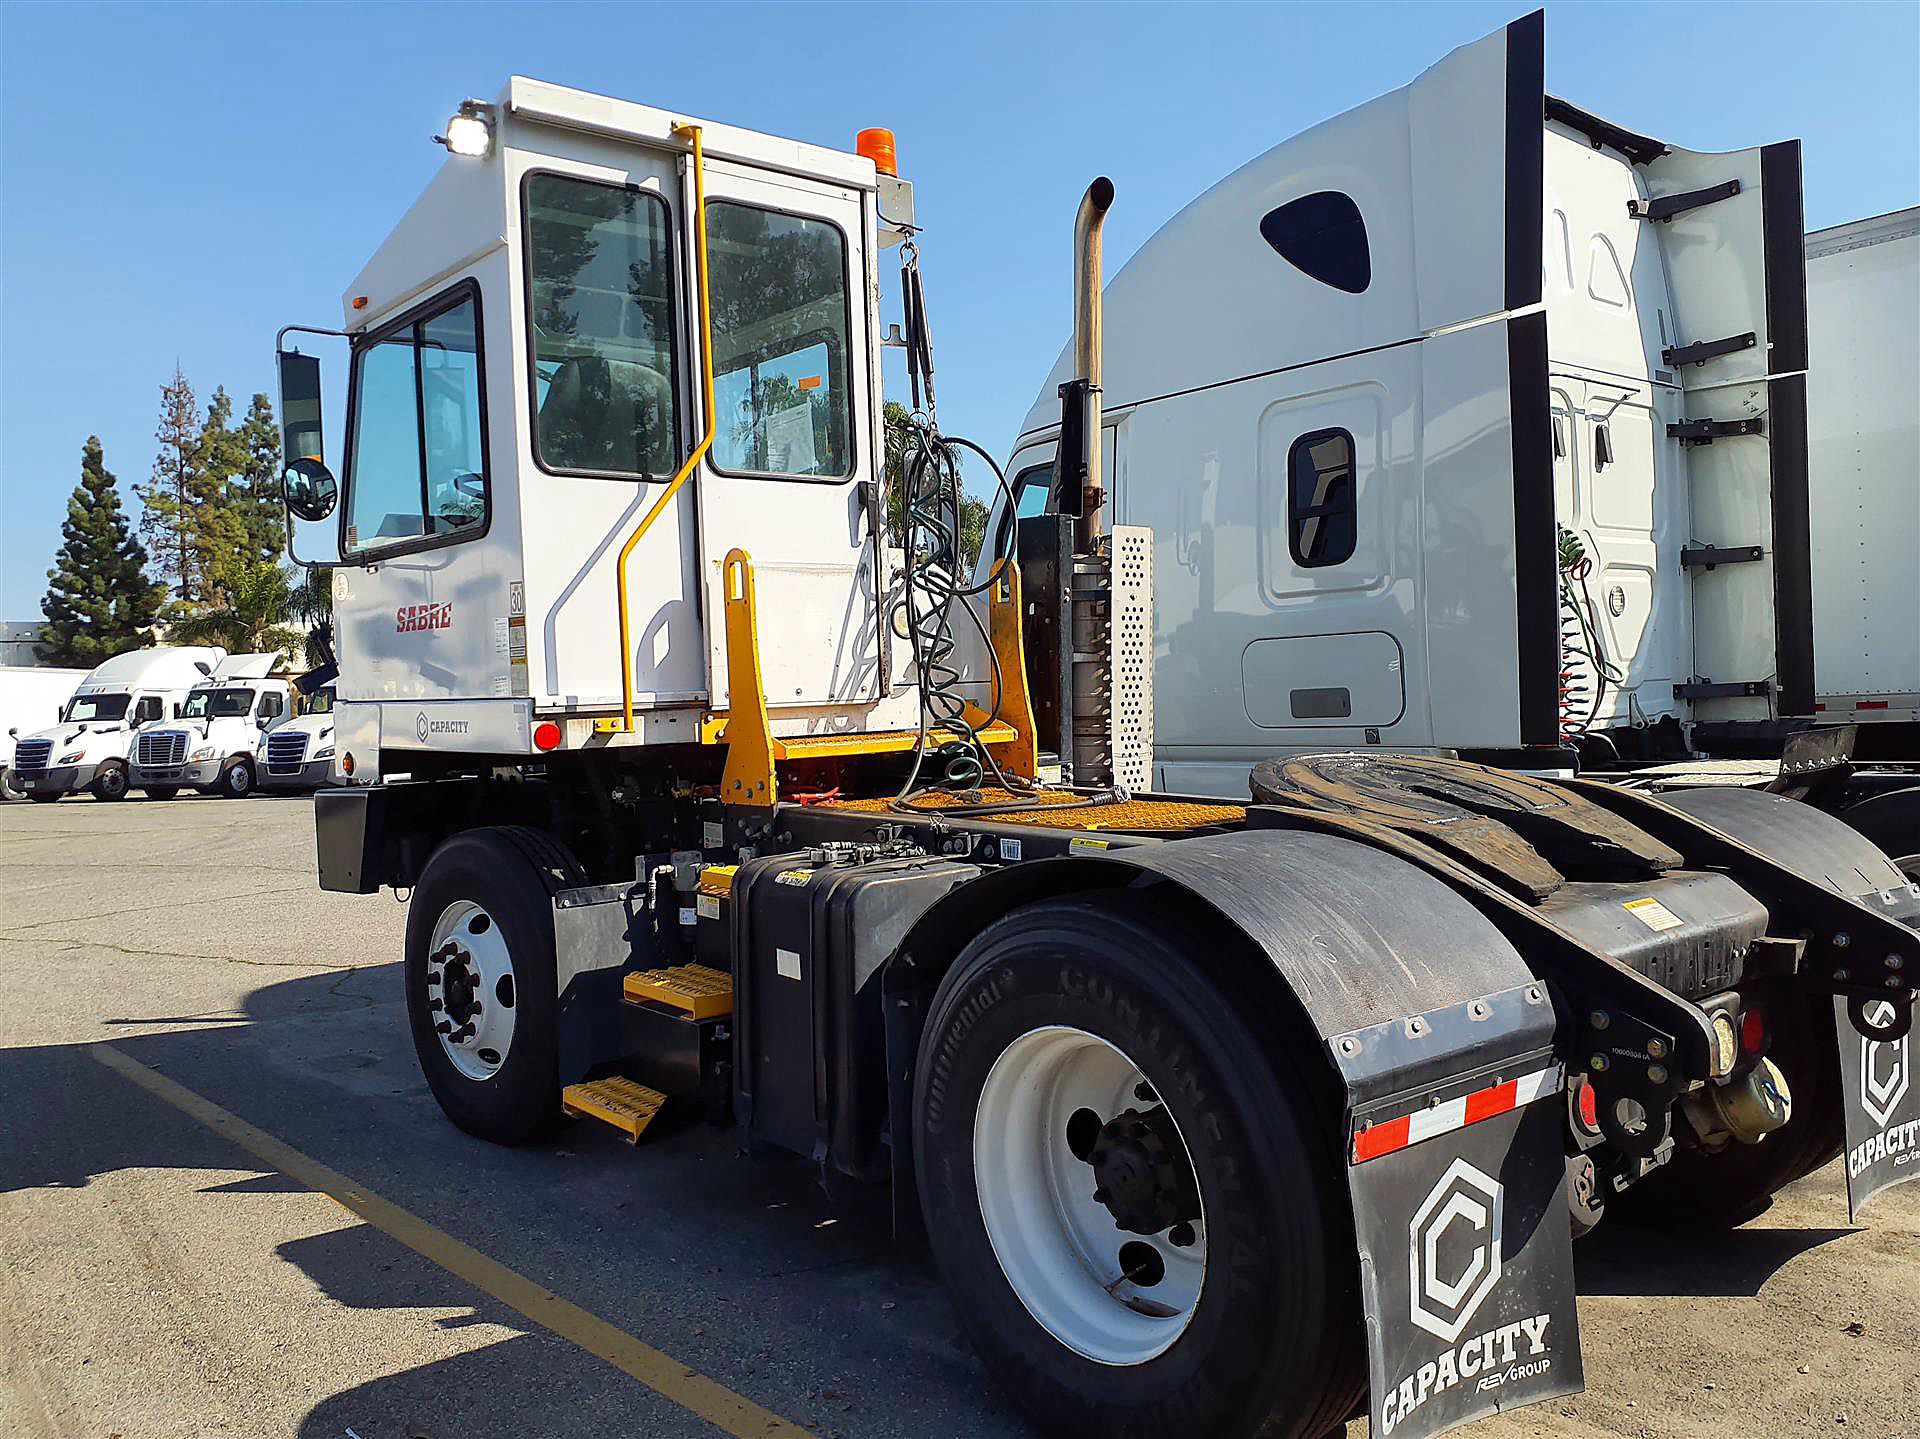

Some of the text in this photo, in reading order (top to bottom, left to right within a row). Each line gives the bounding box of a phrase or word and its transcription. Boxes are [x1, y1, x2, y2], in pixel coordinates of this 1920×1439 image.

[511, 591, 522, 612] 30
[396, 602, 452, 632] SABRE
[430, 721, 469, 733] CAPACITY
[1849, 1118, 1920, 1179] CAPACIT
[1381, 1314, 1551, 1436] CAPACITY
